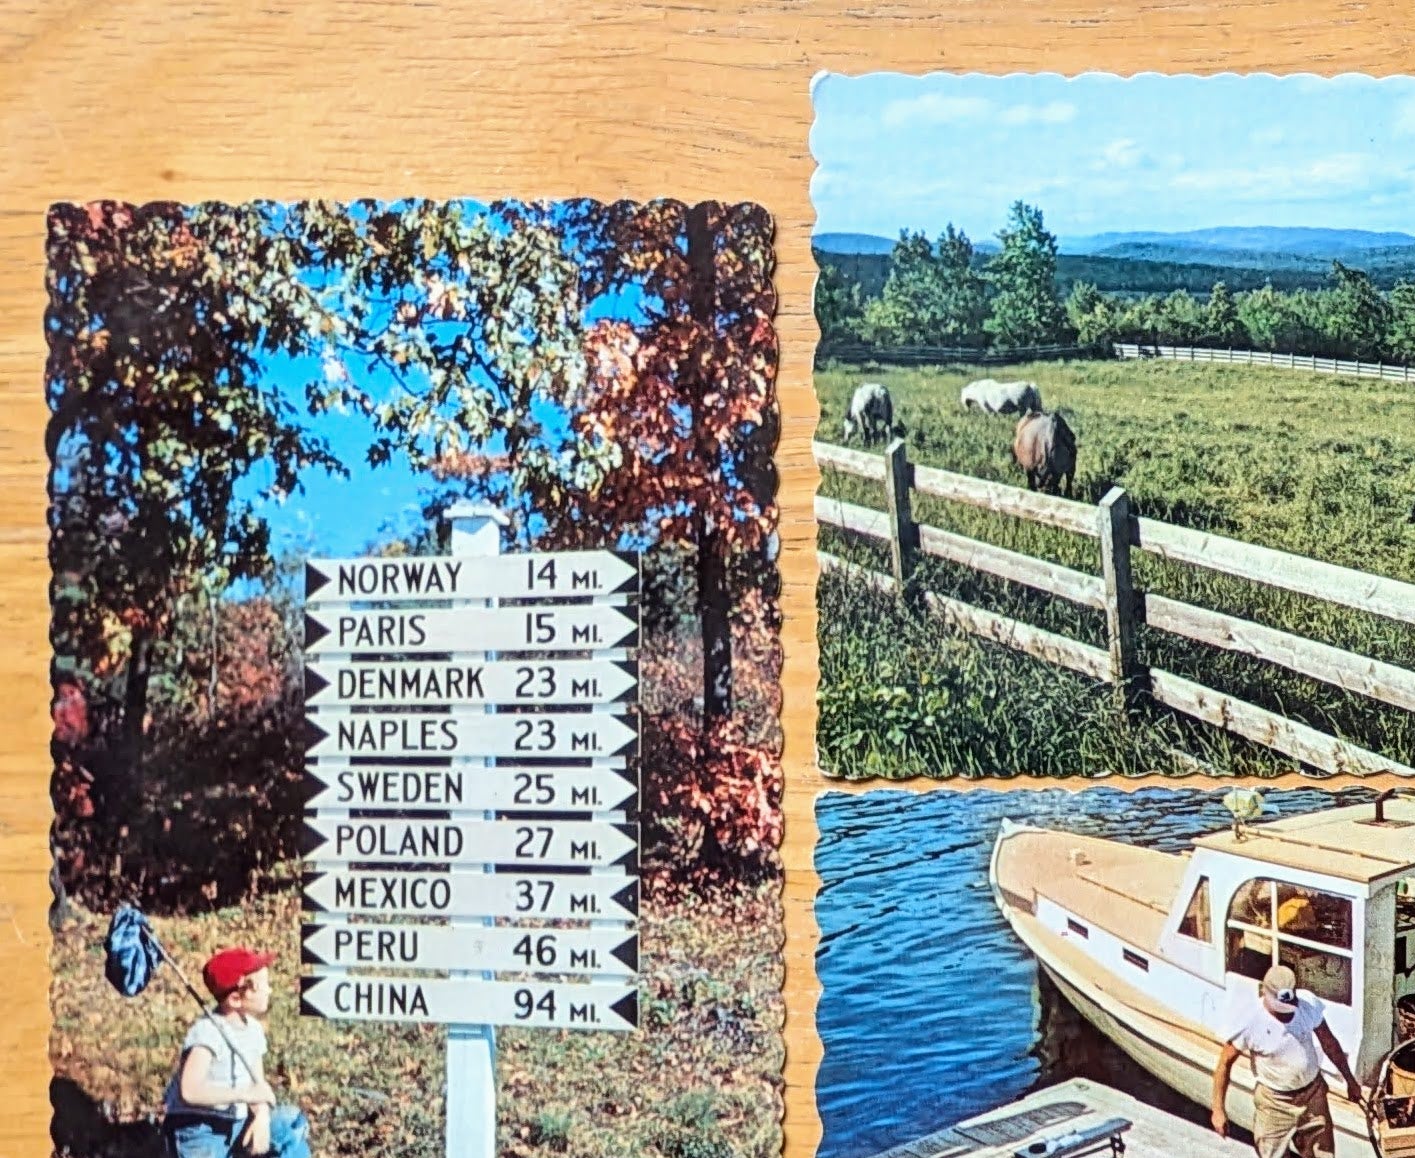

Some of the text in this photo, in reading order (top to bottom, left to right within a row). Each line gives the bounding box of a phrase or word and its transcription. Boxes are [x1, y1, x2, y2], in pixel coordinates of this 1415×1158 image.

[339, 559, 602, 595] NORWAY 14 MI.
[339, 613, 603, 646] PARIS 15 MI.
[338, 666, 603, 699] DENMARK 23 MI.
[338, 719, 602, 751] NAPLES 23 MI.
[337, 771, 602, 805] SWEDEN 25 MI.
[336, 825, 602, 860] POLAND 27 MI.
[335, 877, 601, 913] MEXICO 37 MI.
[335, 930, 602, 968] PERU 46 MI.
[334, 982, 601, 1023] CHINA 94 MI.
